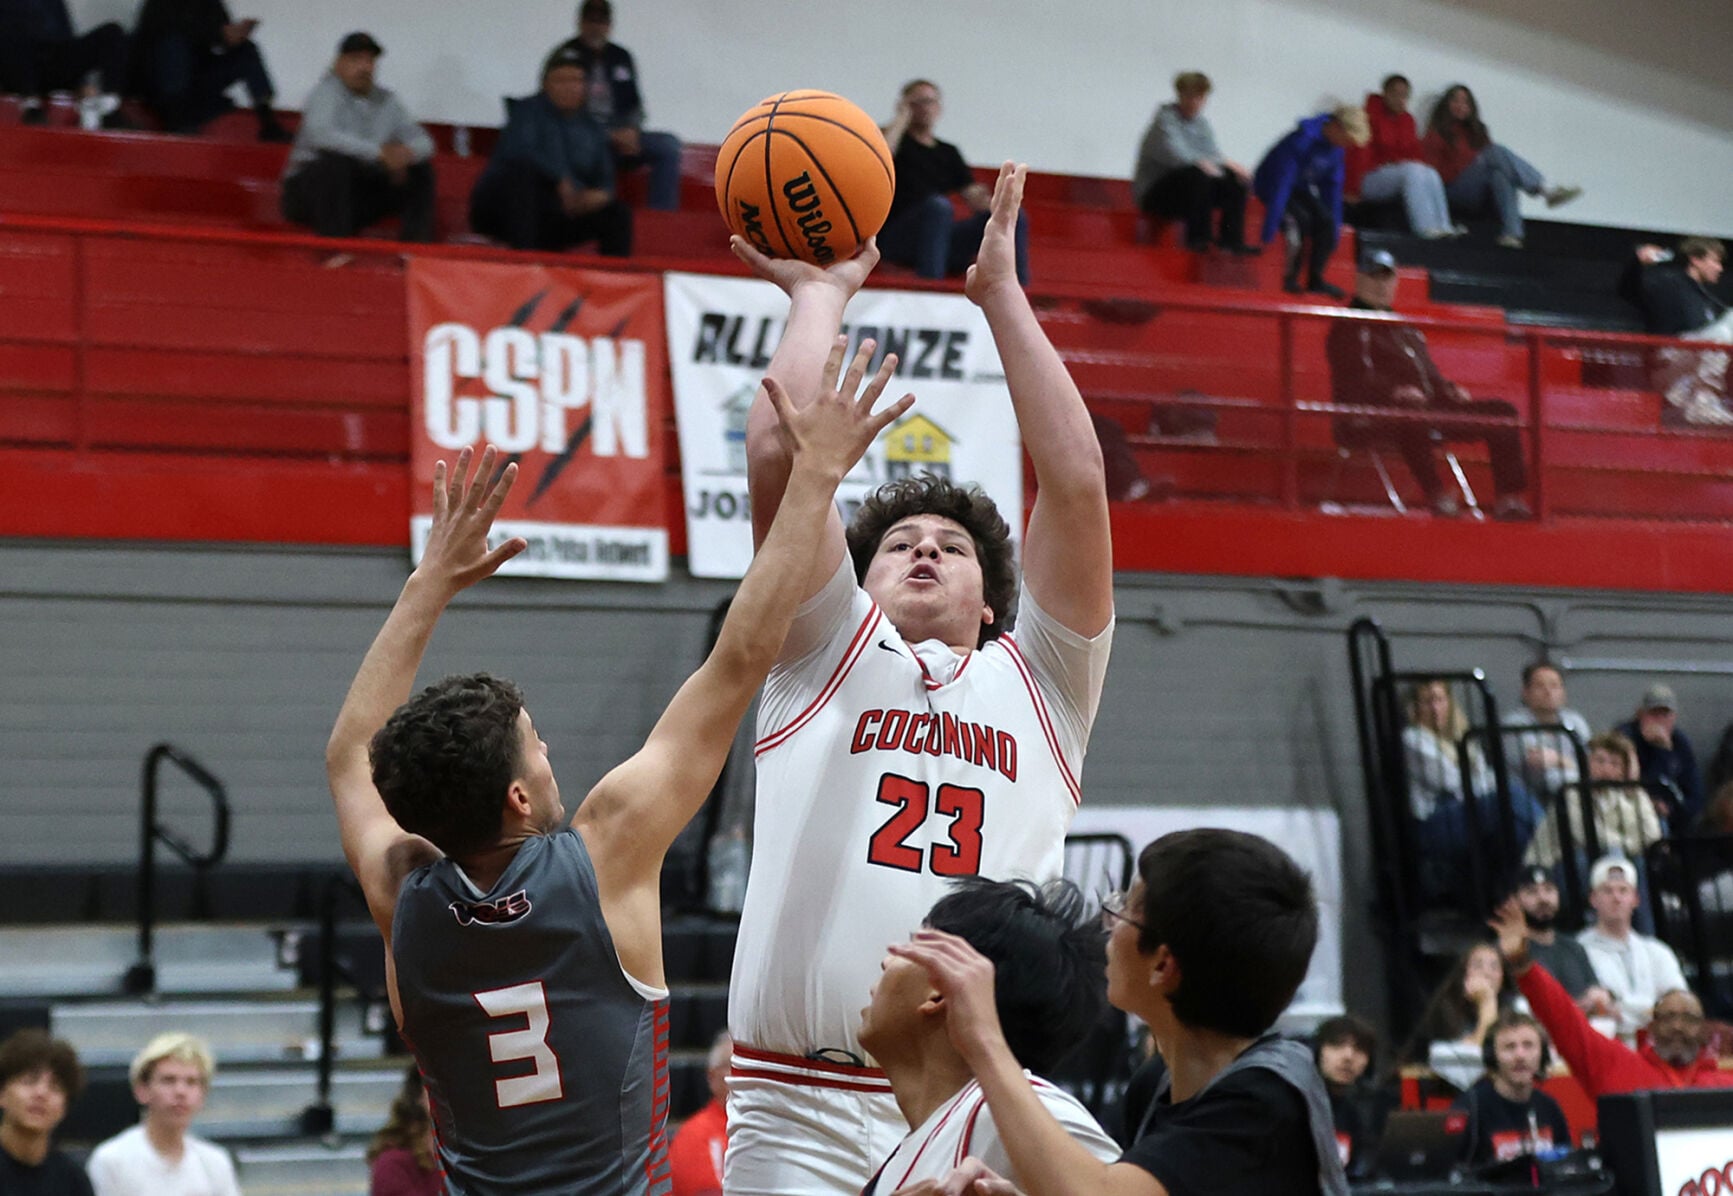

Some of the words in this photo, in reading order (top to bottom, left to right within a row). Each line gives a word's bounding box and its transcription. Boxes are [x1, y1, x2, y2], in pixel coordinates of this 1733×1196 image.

[424, 321, 649, 459] CSPN
[850, 708, 1018, 784] COCONINO
[867, 772, 985, 878] 23
[471, 979, 566, 1110] 3
